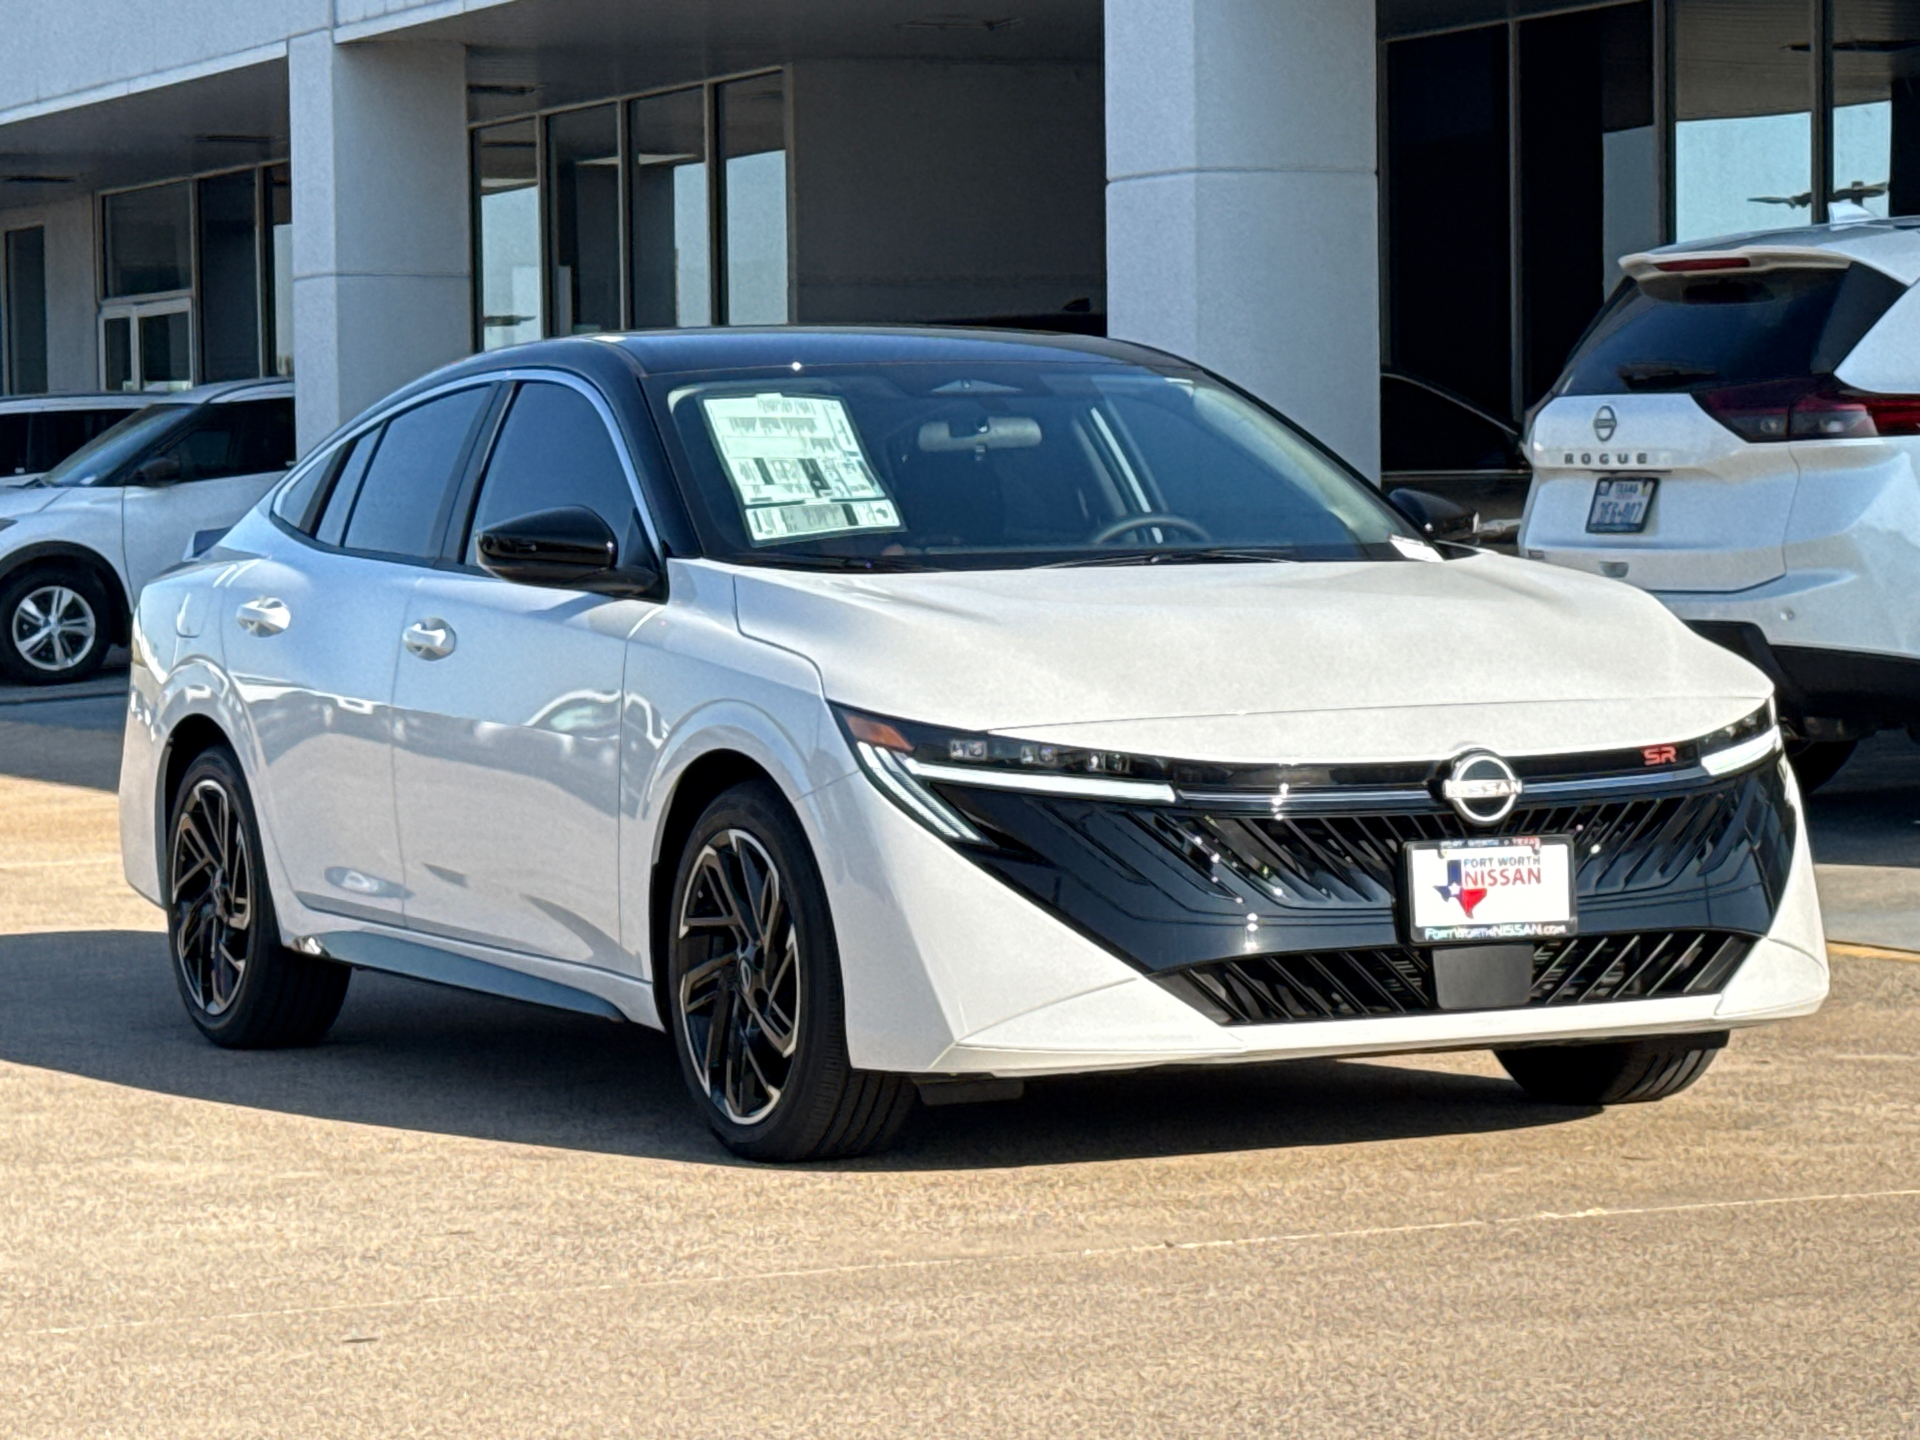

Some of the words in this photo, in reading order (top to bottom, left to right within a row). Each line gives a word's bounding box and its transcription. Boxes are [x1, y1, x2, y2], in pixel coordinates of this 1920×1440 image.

[1564, 453, 1648, 465] ROGUE
[1643, 746, 1676, 765] SR
[1446, 780, 1522, 798] NISSAN
[1464, 857, 1493, 868] FORT
[1498, 856, 1540, 867] WORTH
[1464, 867, 1541, 887] NISSAN
